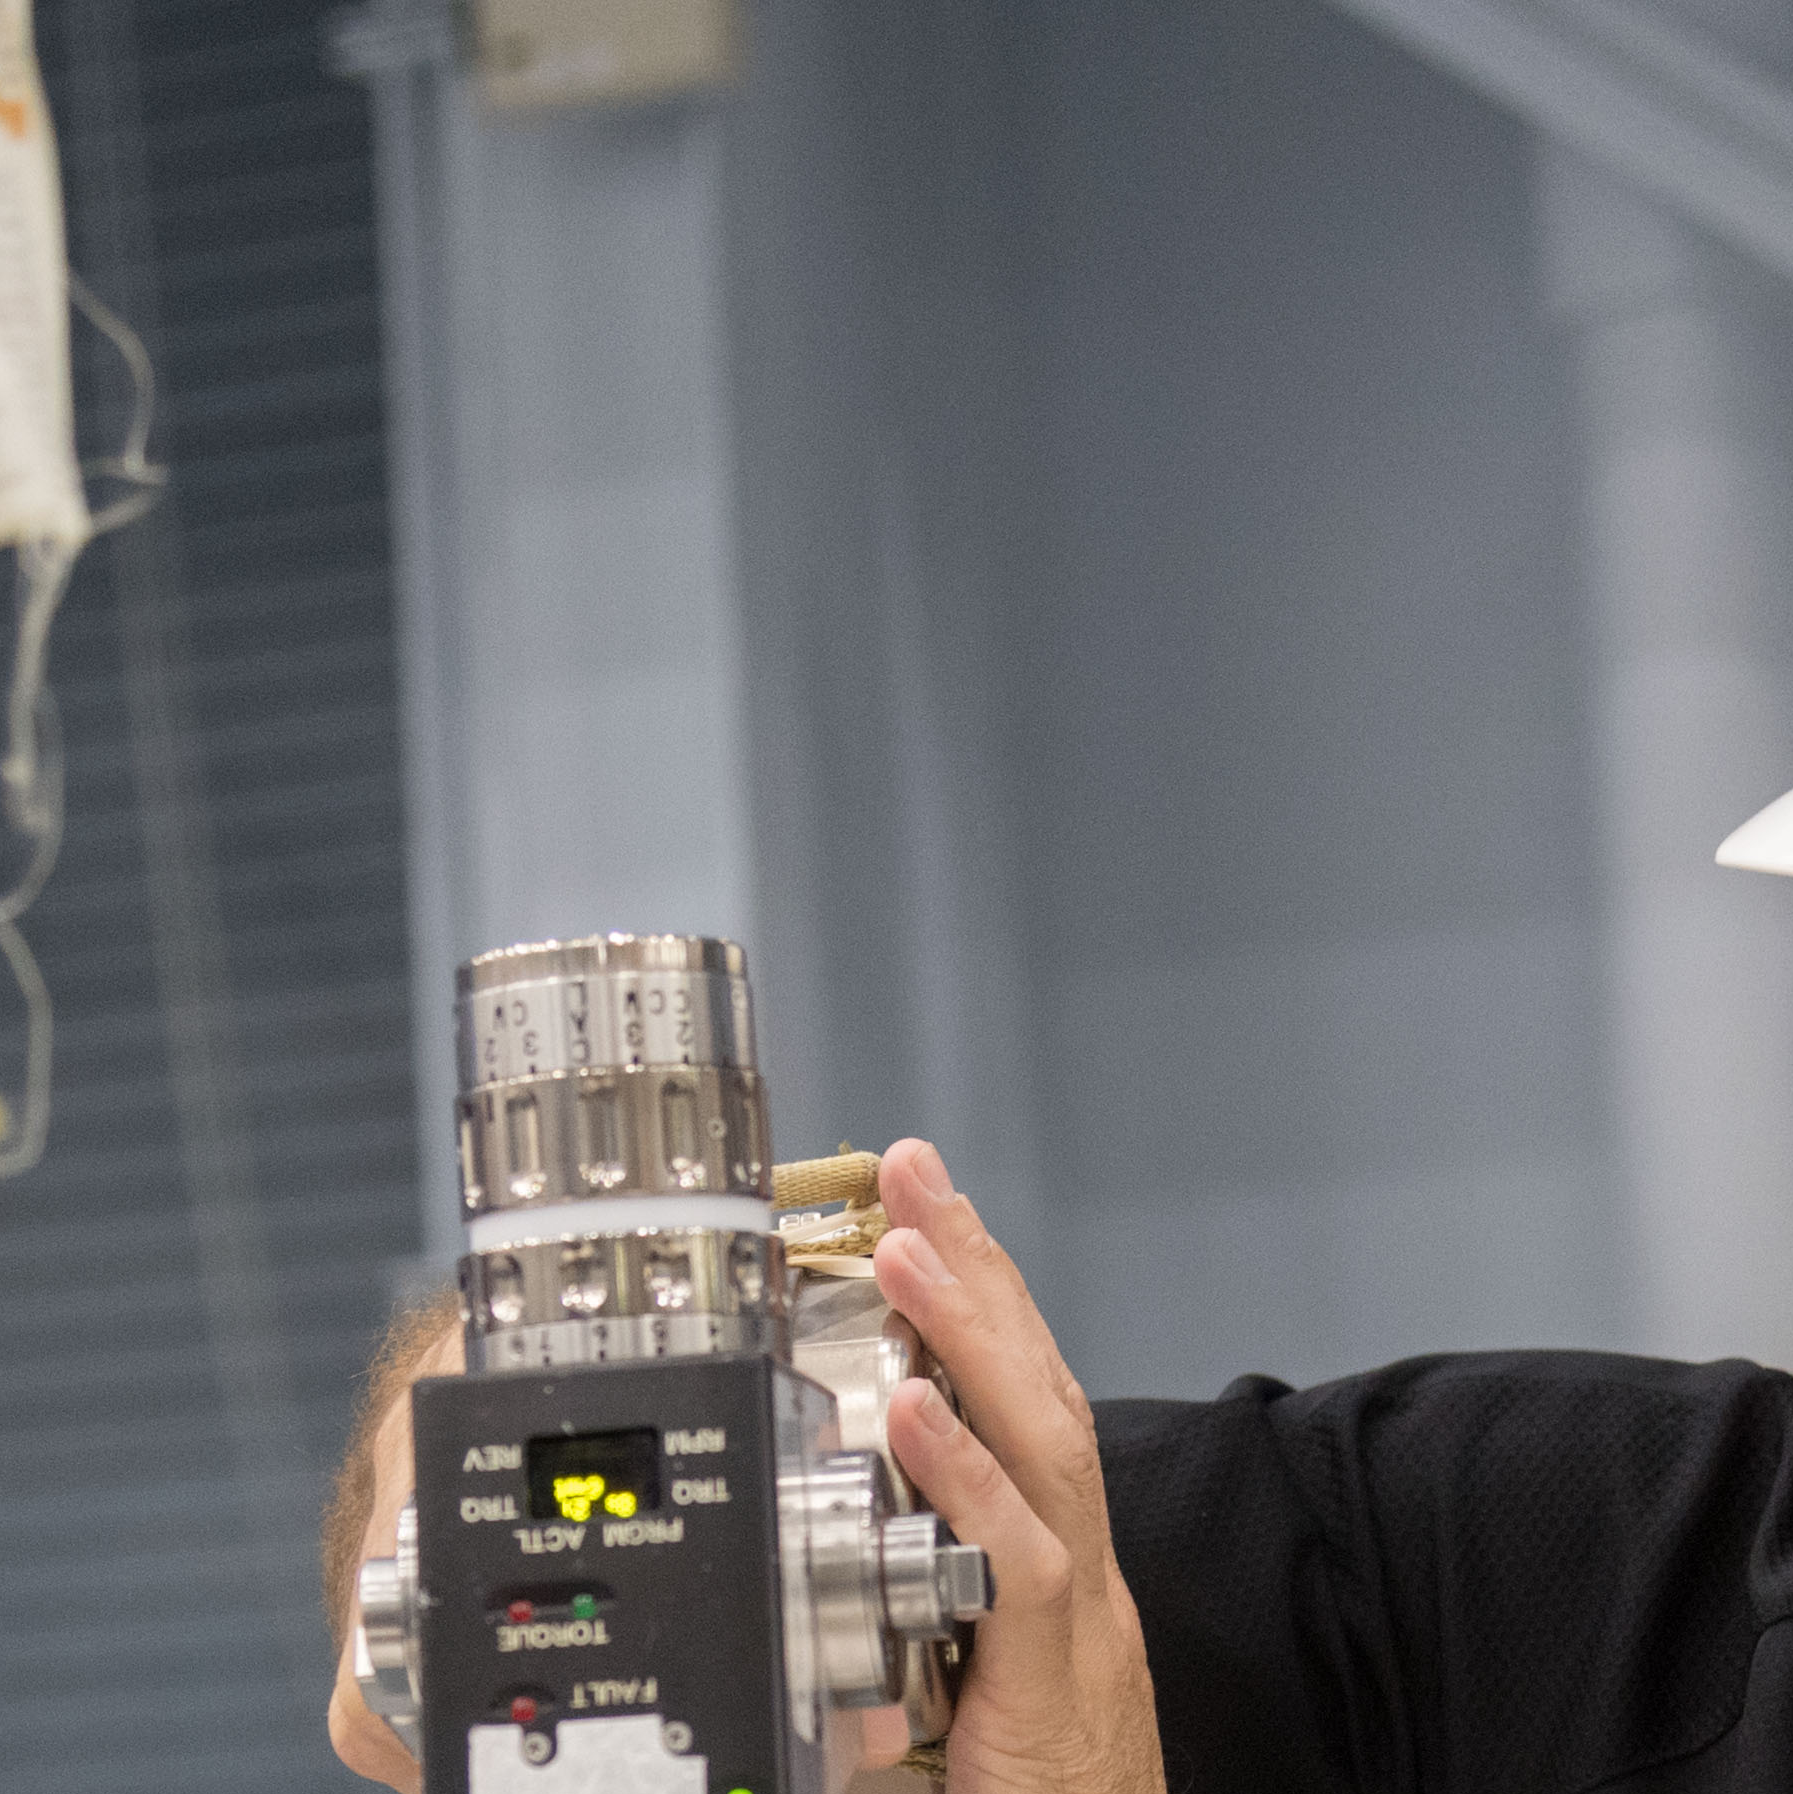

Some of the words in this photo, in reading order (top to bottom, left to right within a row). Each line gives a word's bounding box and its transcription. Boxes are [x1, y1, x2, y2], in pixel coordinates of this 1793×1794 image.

[665, 1428, 726, 1457] RPM
[463, 1444, 522, 1473] REV
[671, 1477, 730, 1506] TRQ
[460, 1496, 518, 1522] TRQ
[514, 1525, 587, 1555] ACTL
[603, 1517, 684, 1549] PRGM
[497, 1619, 611, 1653] TORQUE
[570, 1676, 658, 1709] FAULT
